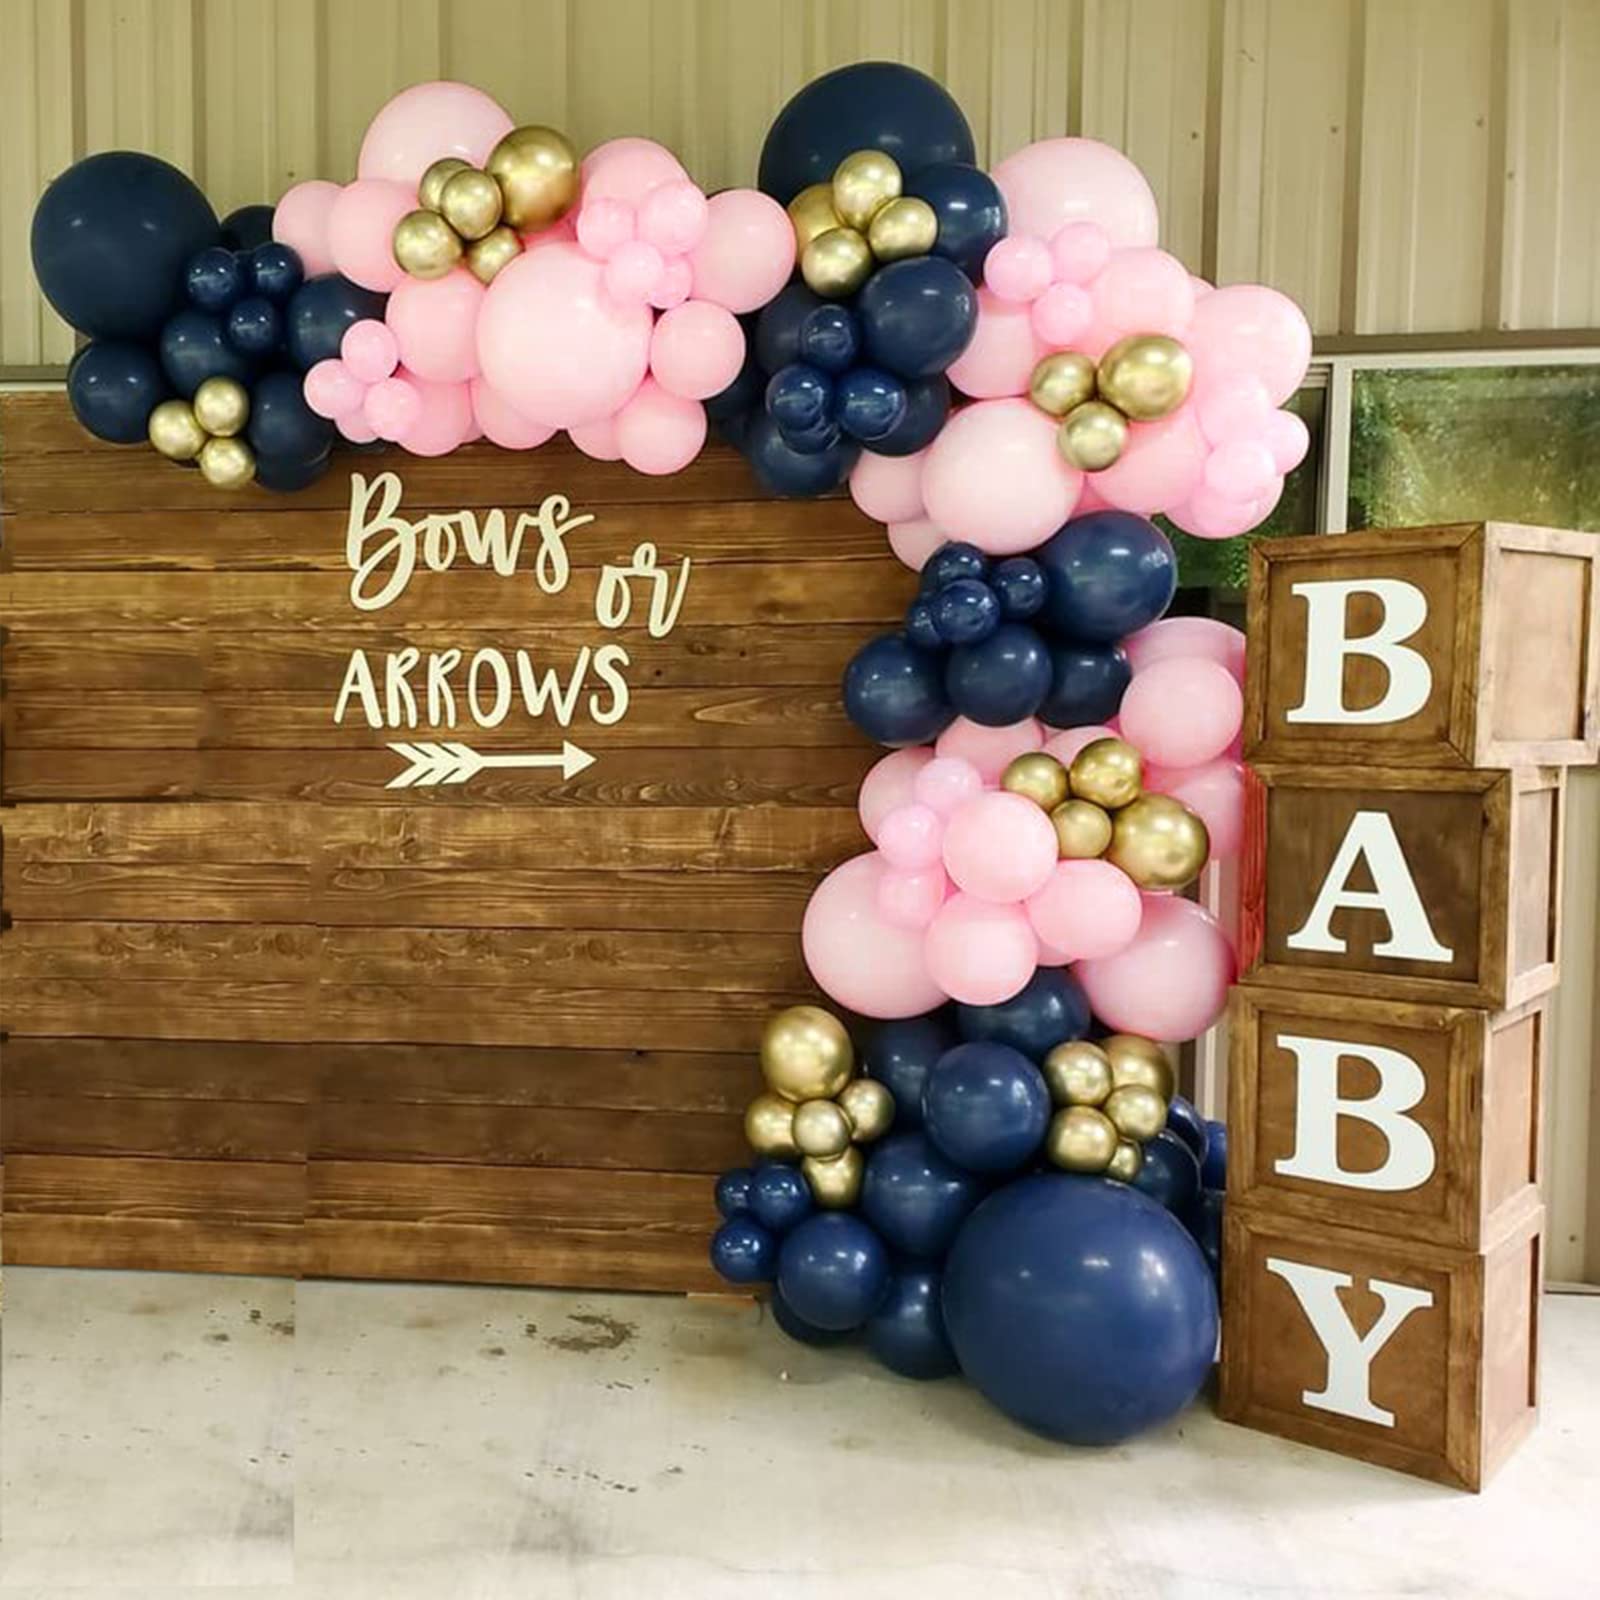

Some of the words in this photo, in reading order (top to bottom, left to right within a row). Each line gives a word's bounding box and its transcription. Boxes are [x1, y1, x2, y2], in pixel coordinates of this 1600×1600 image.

[346, 472, 594, 610] Bows
[596, 542, 690, 638] or
[334, 644, 630, 729] ARROWS
